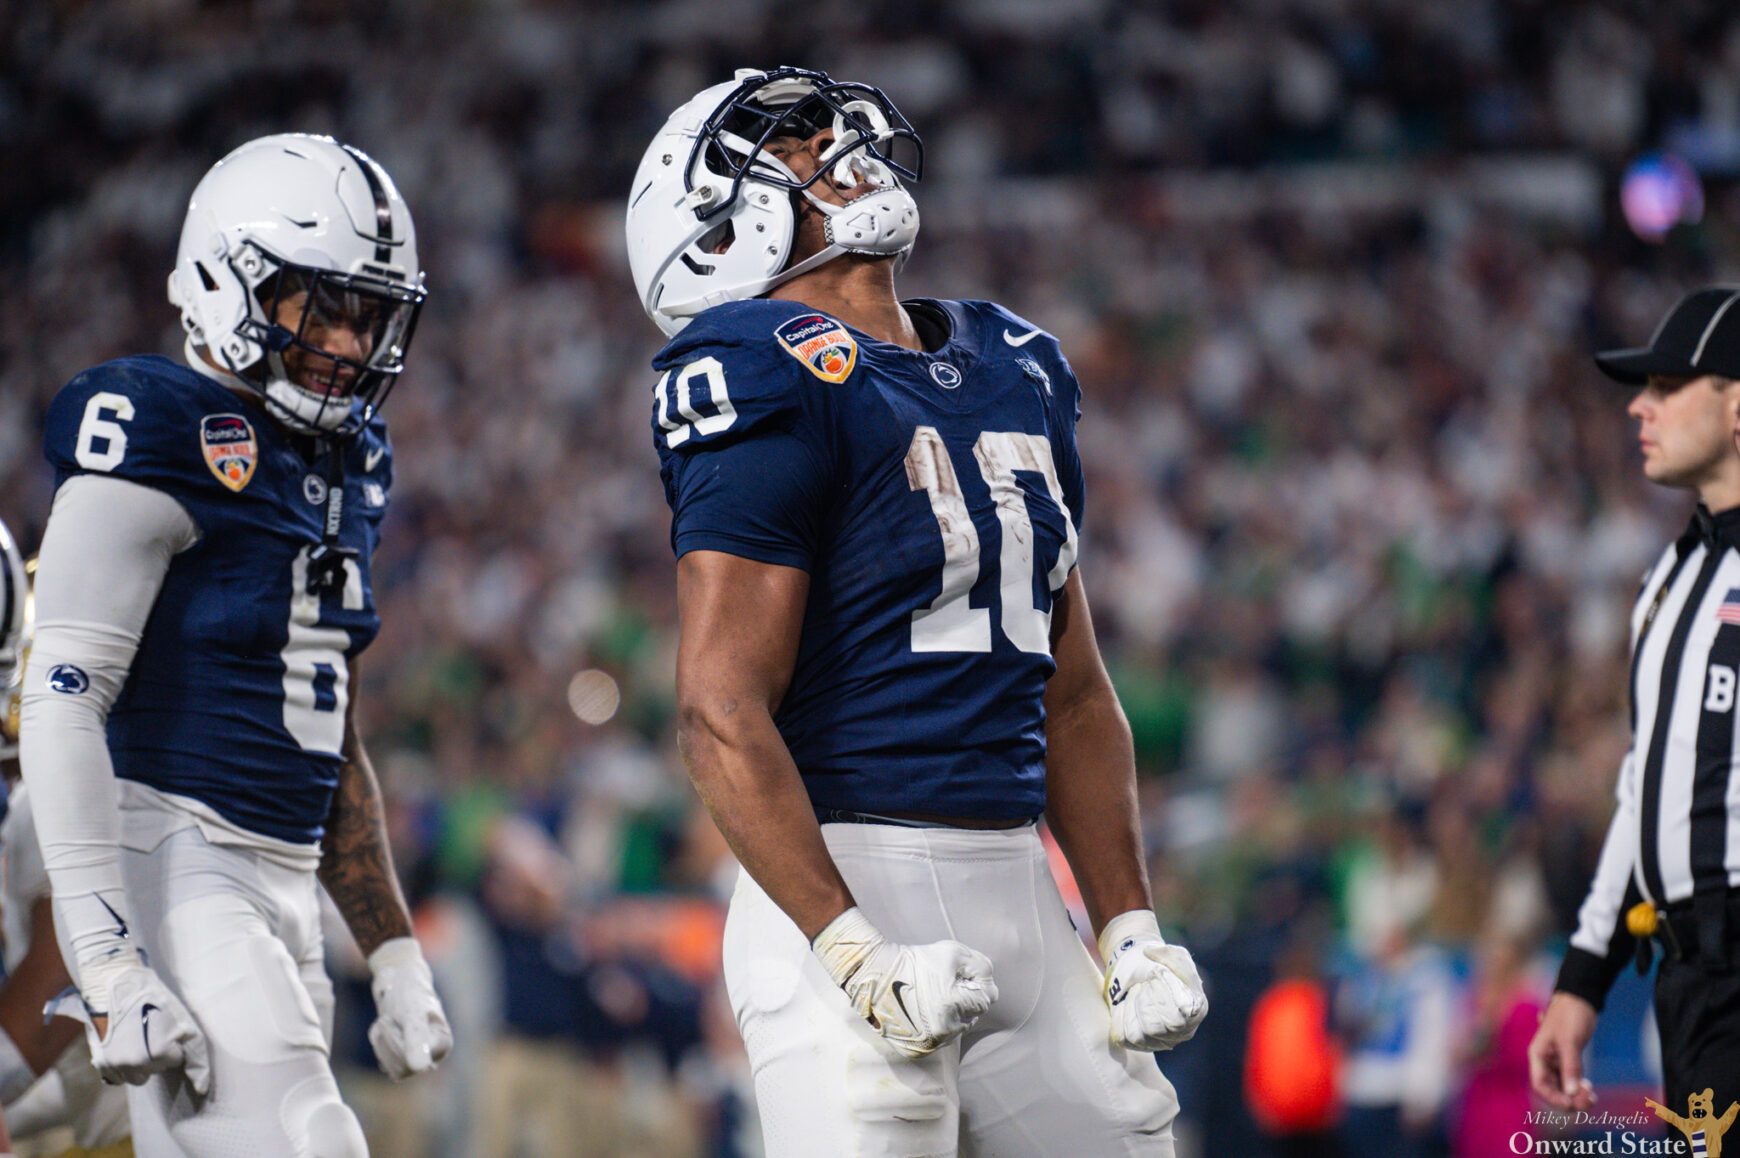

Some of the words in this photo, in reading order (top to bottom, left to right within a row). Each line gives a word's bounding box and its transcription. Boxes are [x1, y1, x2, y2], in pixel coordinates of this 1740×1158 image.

[74, 391, 136, 472] 6
[655, 356, 738, 450] 10
[903, 425, 1078, 658] 10
[280, 544, 364, 758] 6
[1704, 664, 1736, 713] B
